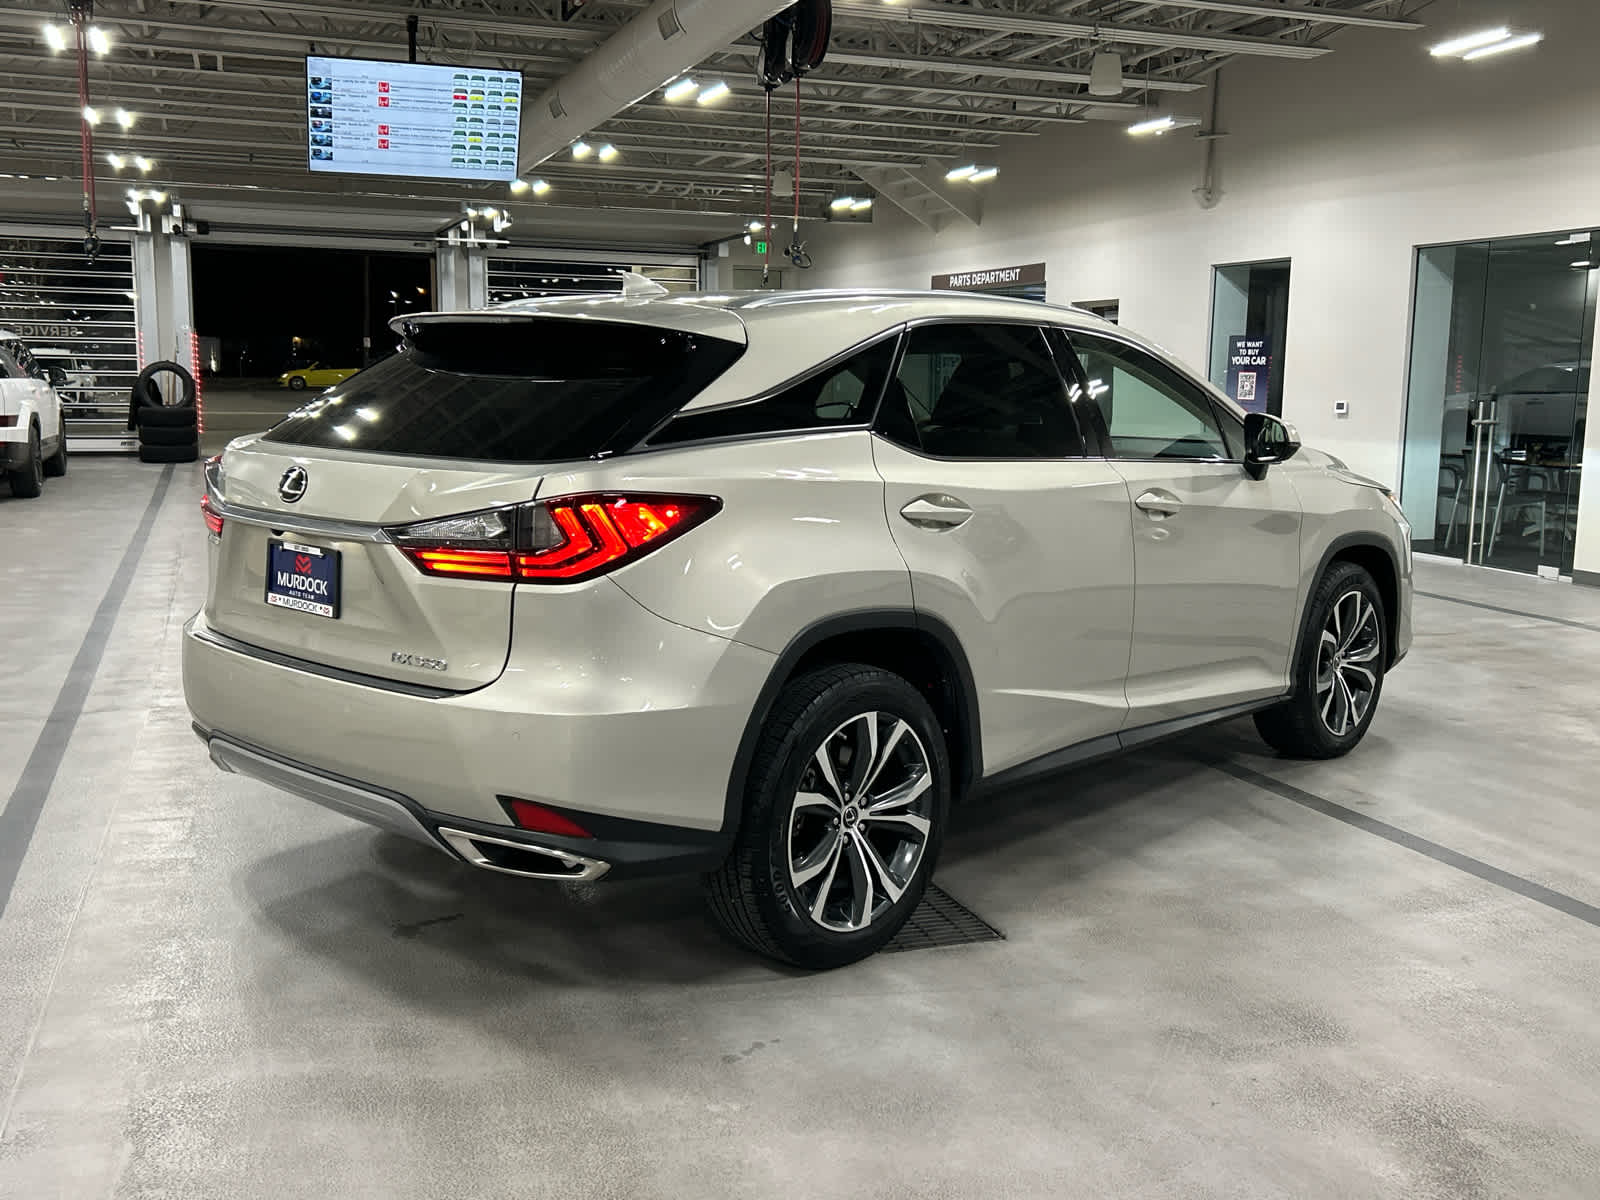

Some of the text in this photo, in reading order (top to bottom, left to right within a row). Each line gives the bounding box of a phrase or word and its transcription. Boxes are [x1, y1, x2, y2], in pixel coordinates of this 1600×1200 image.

[949, 268, 1021, 288] PARTS DEPARTMENT
[1231, 356, 1266, 365] YOUR CAR
[277, 571, 328, 596] MURDOCK
